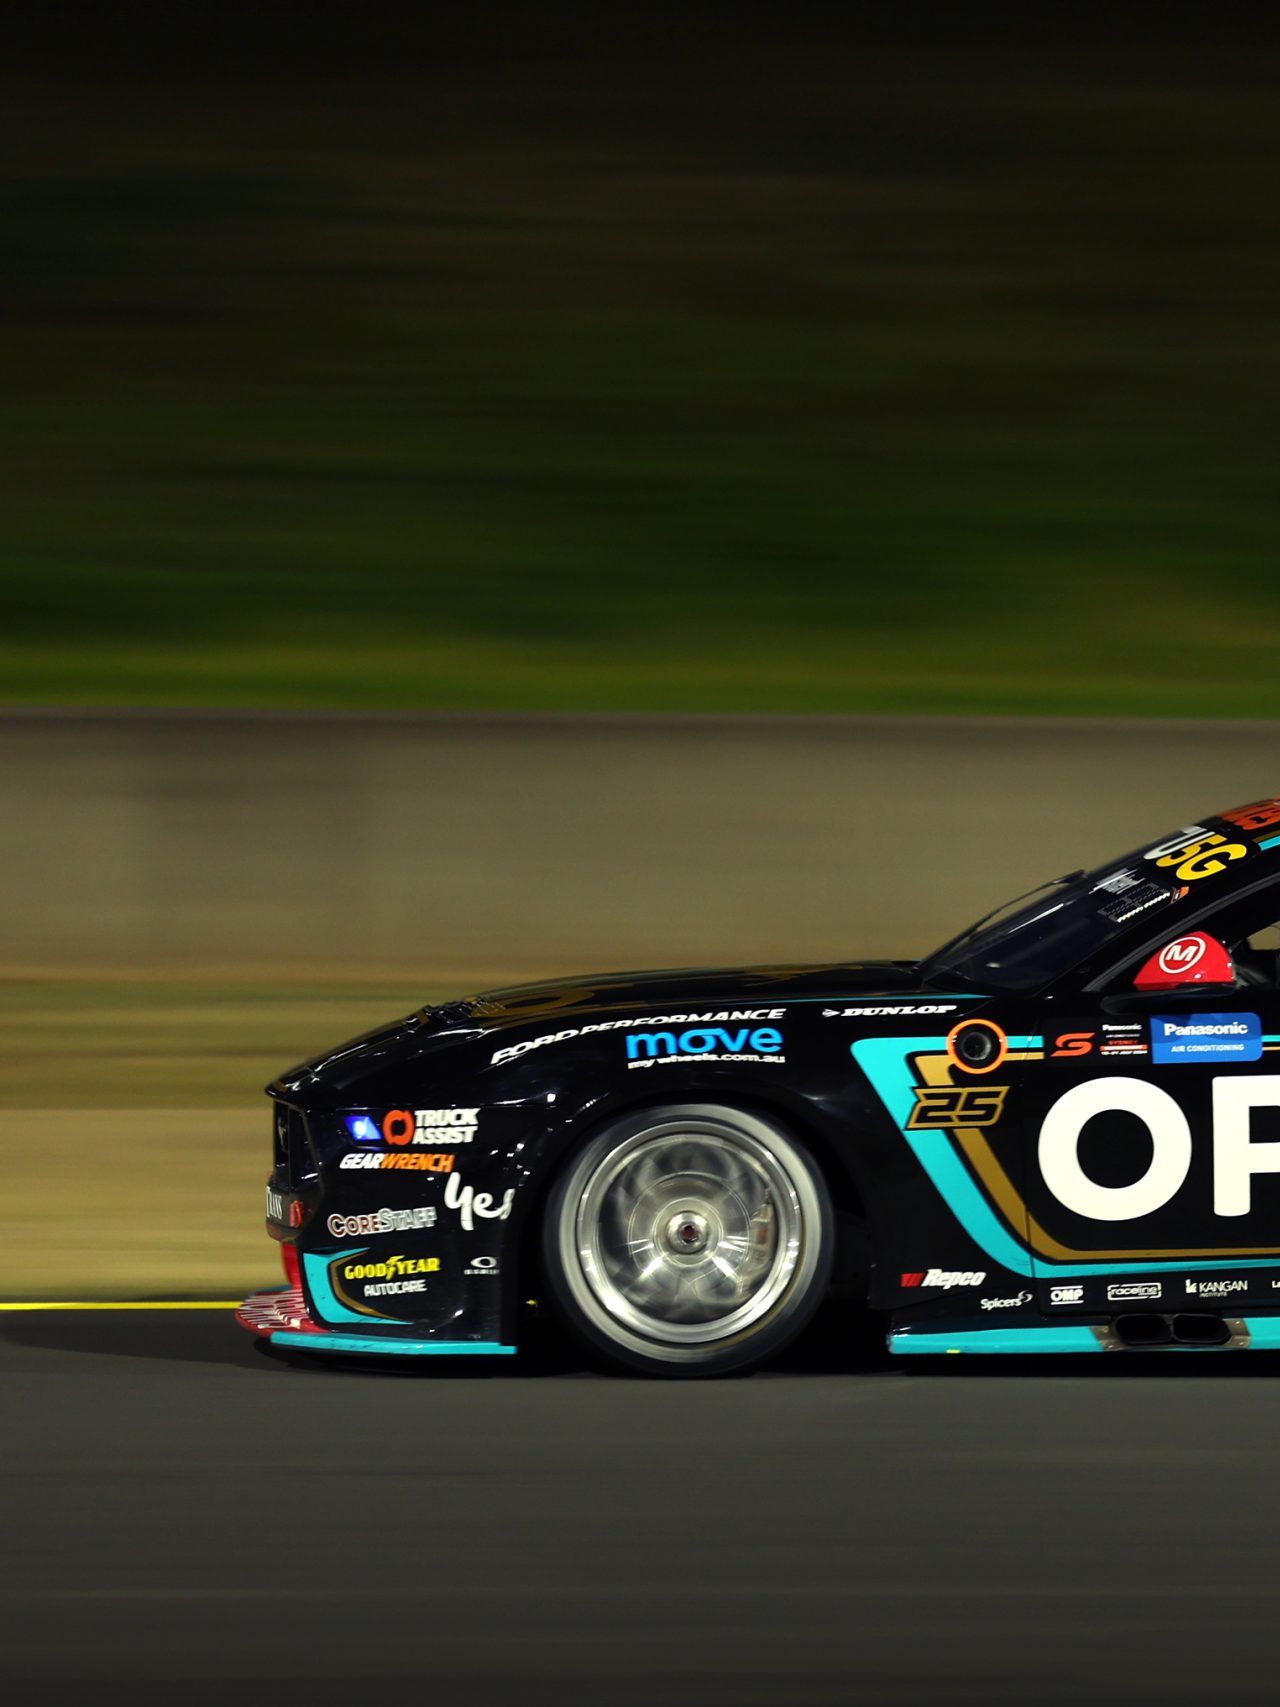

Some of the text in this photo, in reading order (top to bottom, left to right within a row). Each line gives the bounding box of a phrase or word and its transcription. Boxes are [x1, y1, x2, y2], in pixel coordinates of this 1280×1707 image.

[1156, 834, 1247, 880] 5G
[840, 1005, 957, 1017] DUNLOP
[490, 1008, 786, 1064] FORD PERFORMANCE
[1164, 1021, 1249, 1037] Panasonic
[625, 1027, 783, 1059] move
[1171, 1044, 1245, 1053] AIR CONDITIONING
[906, 1086, 1010, 1129] 25
[414, 1108, 481, 1126] TRUCK
[412, 1126, 478, 1144] ASSIST
[340, 1153, 455, 1172] GEARWRENCH
[344, 1255, 441, 1281] GOODYEAR
[364, 1279, 427, 1297] AUTOCARE
[921, 1269, 986, 1289] Repco
[1199, 1280, 1248, 1293] KANGAN
[1050, 1288, 1083, 1302] OMP
[1110, 1286, 1159, 1296] raceline
[980, 1296, 1022, 1310] Spicers
